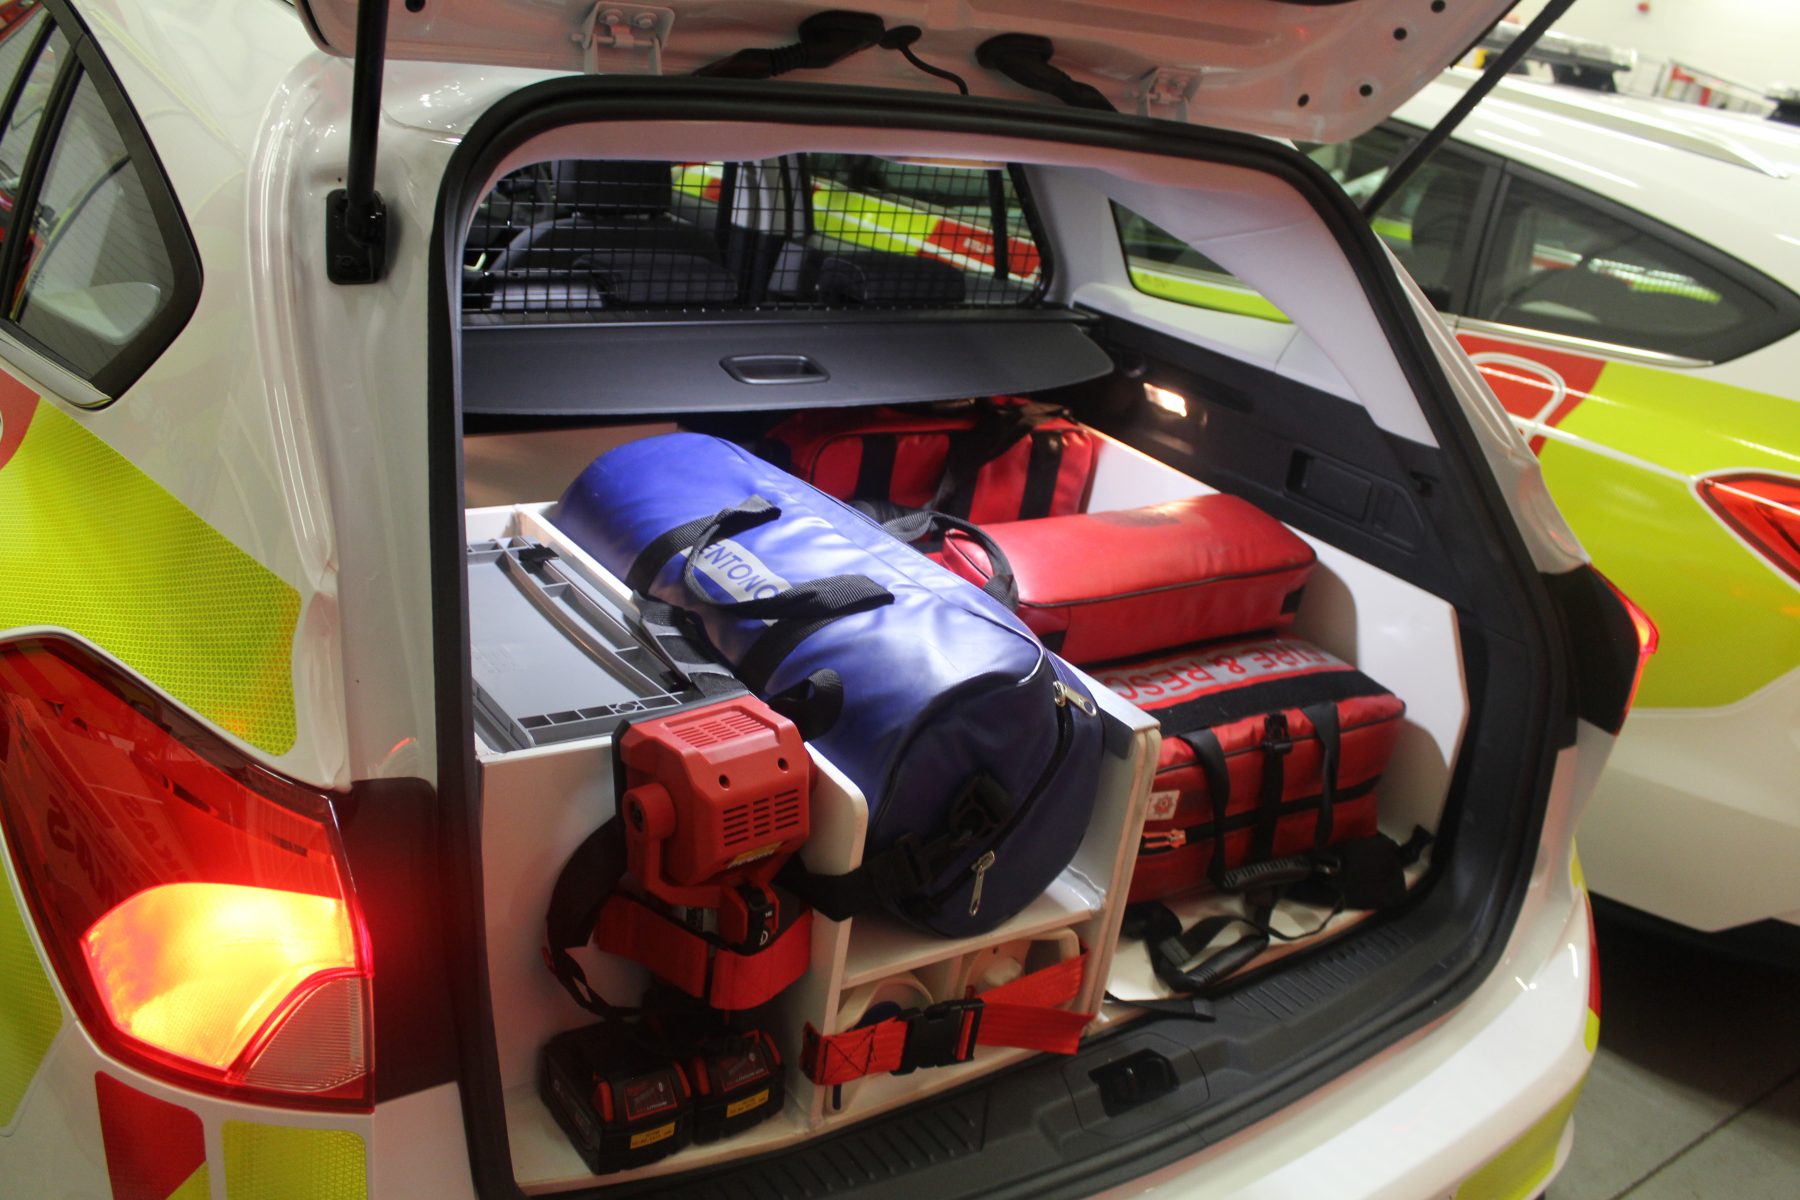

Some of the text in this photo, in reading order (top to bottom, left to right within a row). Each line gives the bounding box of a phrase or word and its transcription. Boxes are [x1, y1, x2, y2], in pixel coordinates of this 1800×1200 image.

[699, 543, 779, 600] NTONO
[1103, 643, 1328, 700] FIRE & RESC
